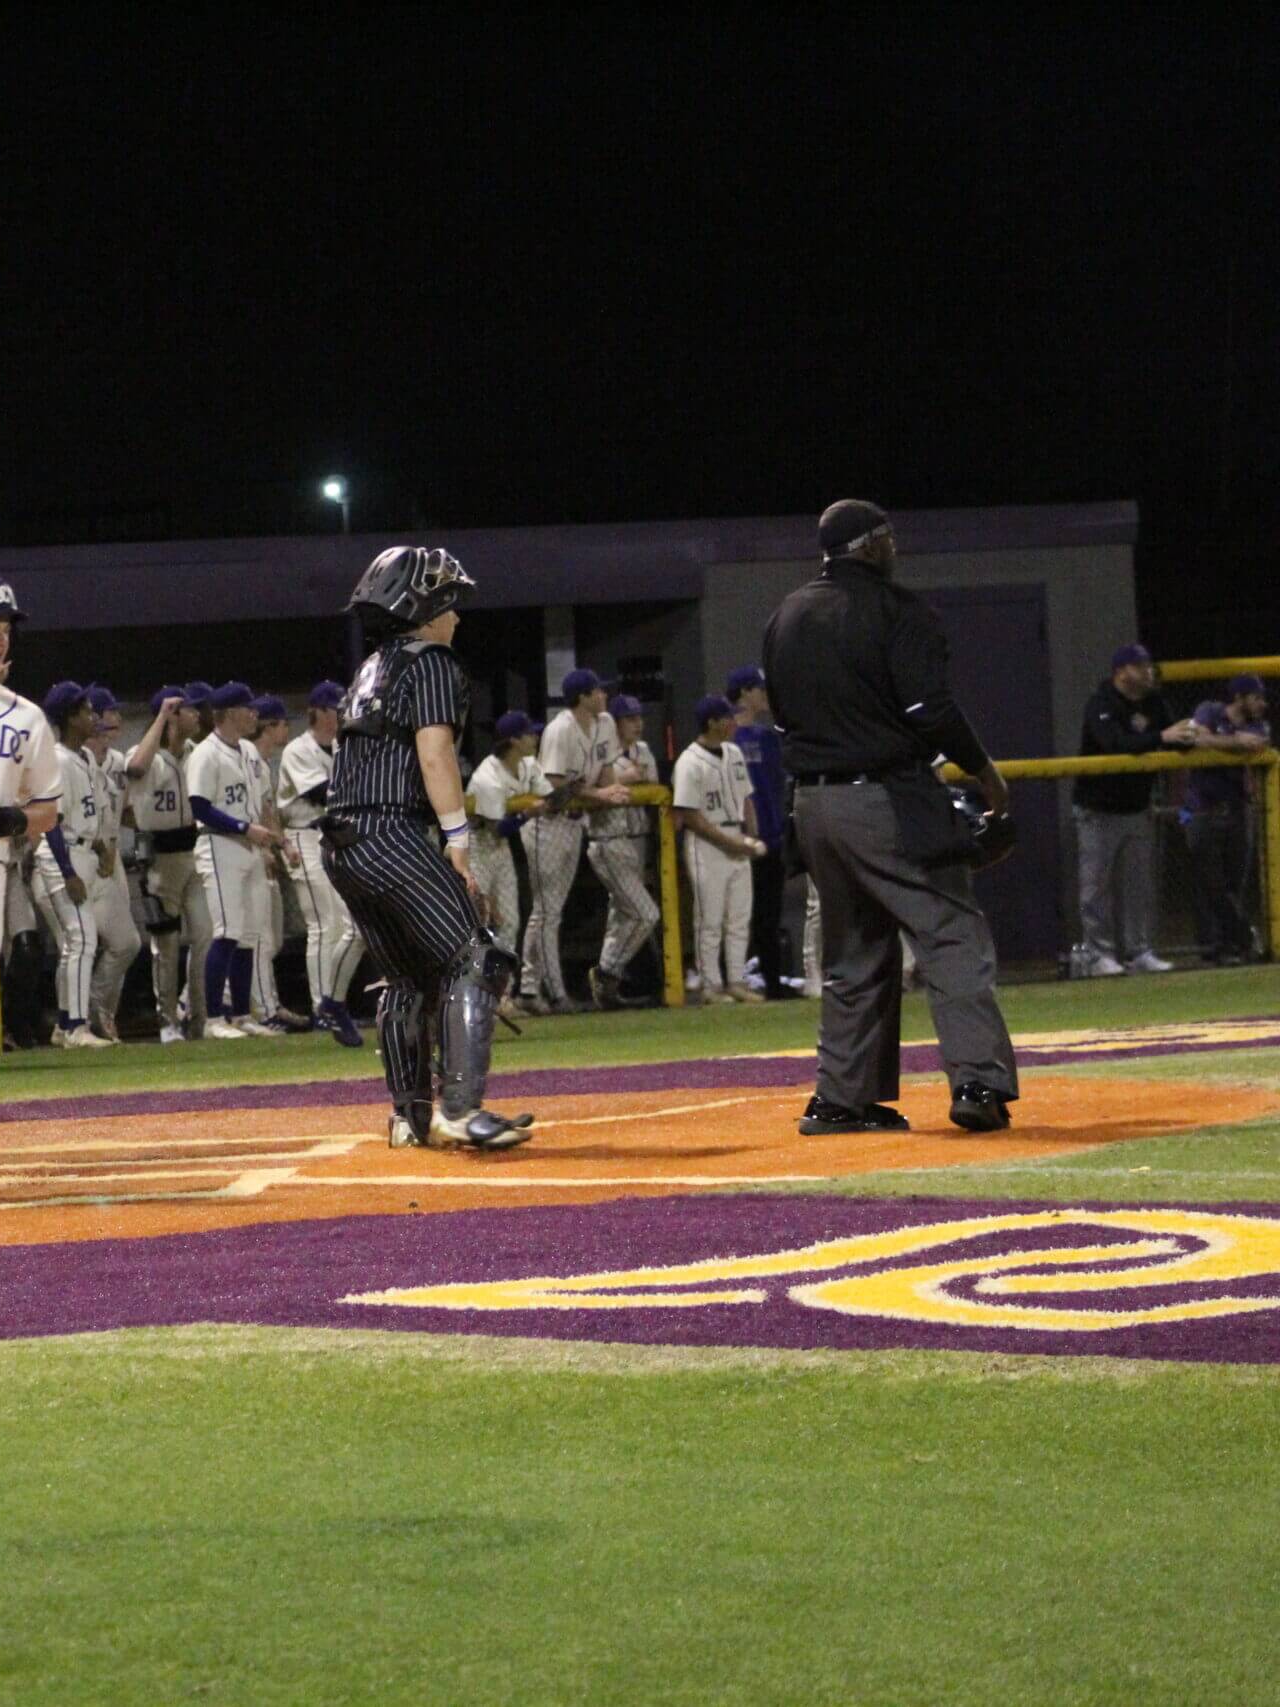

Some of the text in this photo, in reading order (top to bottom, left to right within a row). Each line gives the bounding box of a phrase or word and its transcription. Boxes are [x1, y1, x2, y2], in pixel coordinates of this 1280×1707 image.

[153, 790, 176, 812] 28
[224, 783, 247, 805] 32
[705, 791, 720, 811] 31
